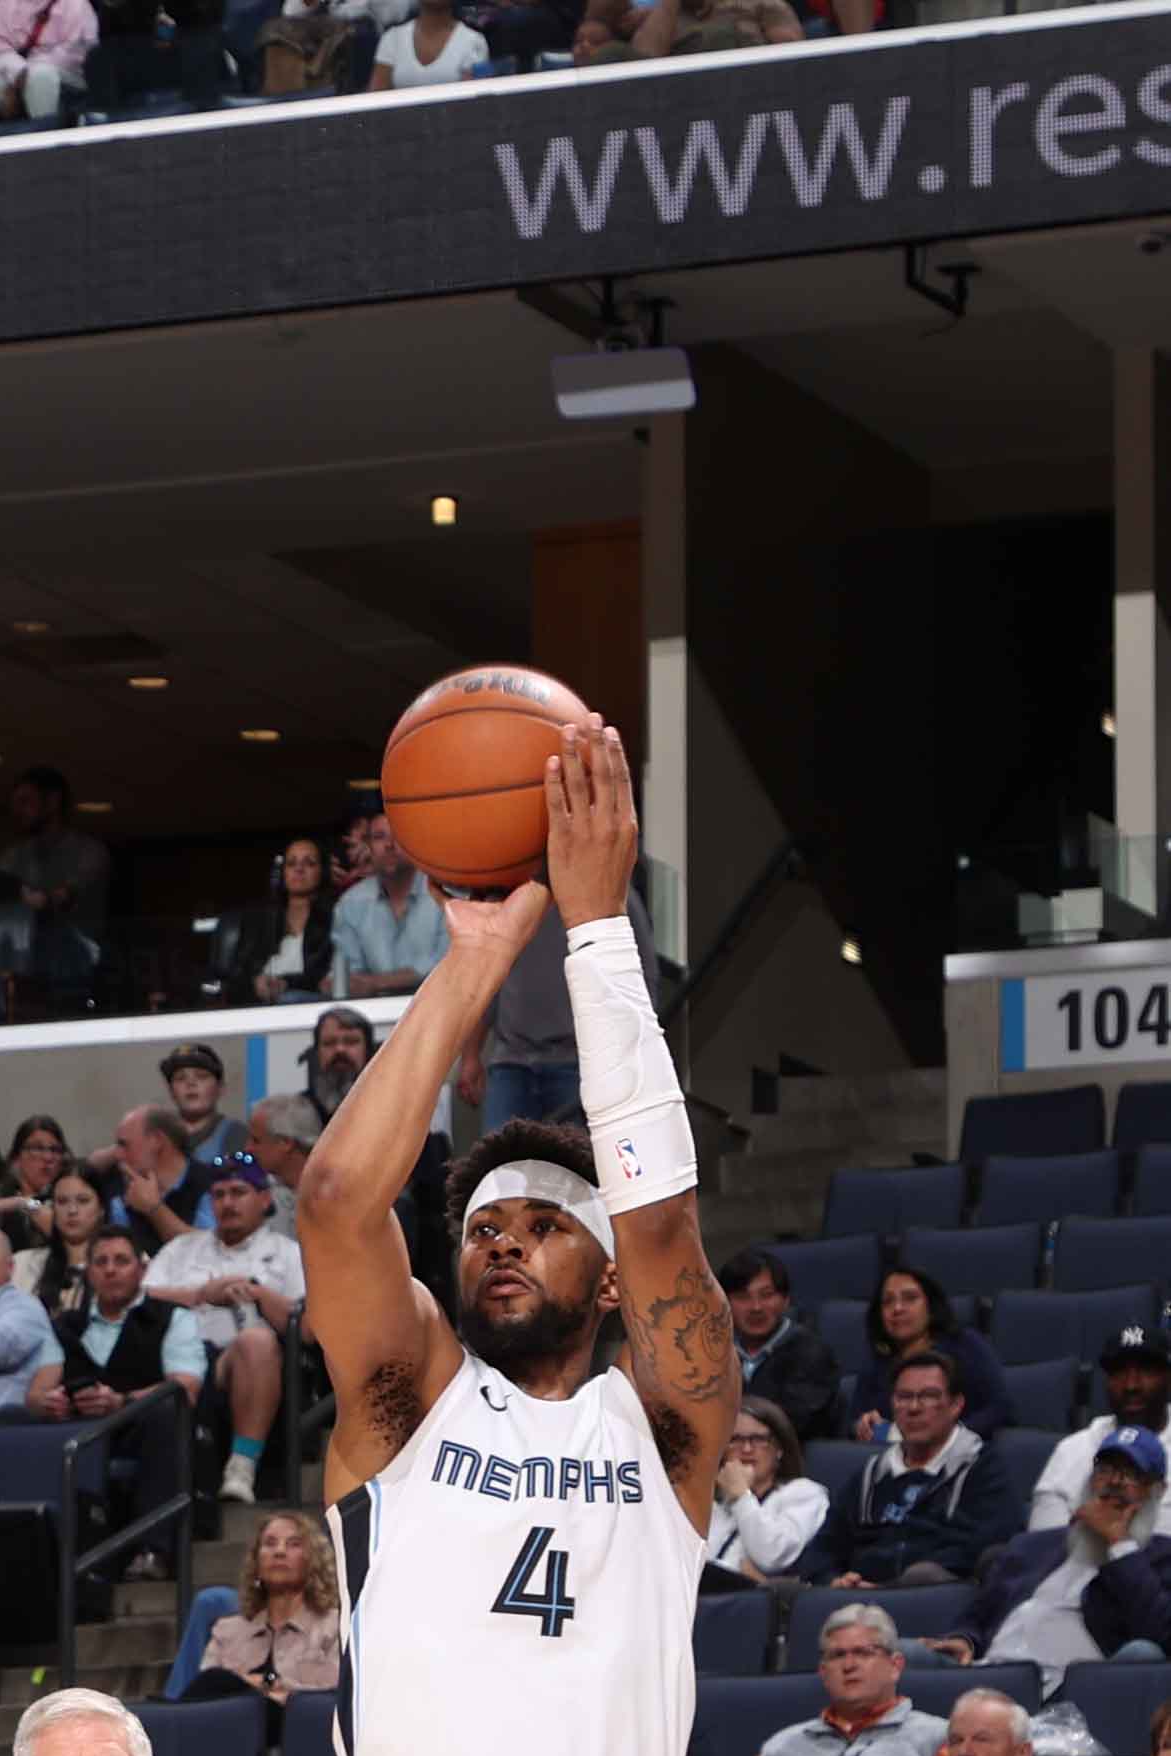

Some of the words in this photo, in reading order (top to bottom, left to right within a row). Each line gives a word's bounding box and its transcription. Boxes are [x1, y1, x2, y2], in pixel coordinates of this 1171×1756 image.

[1059, 985, 1171, 1052] 104
[431, 1440, 643, 1504] MEMPHS
[490, 1526, 575, 1638] 4
